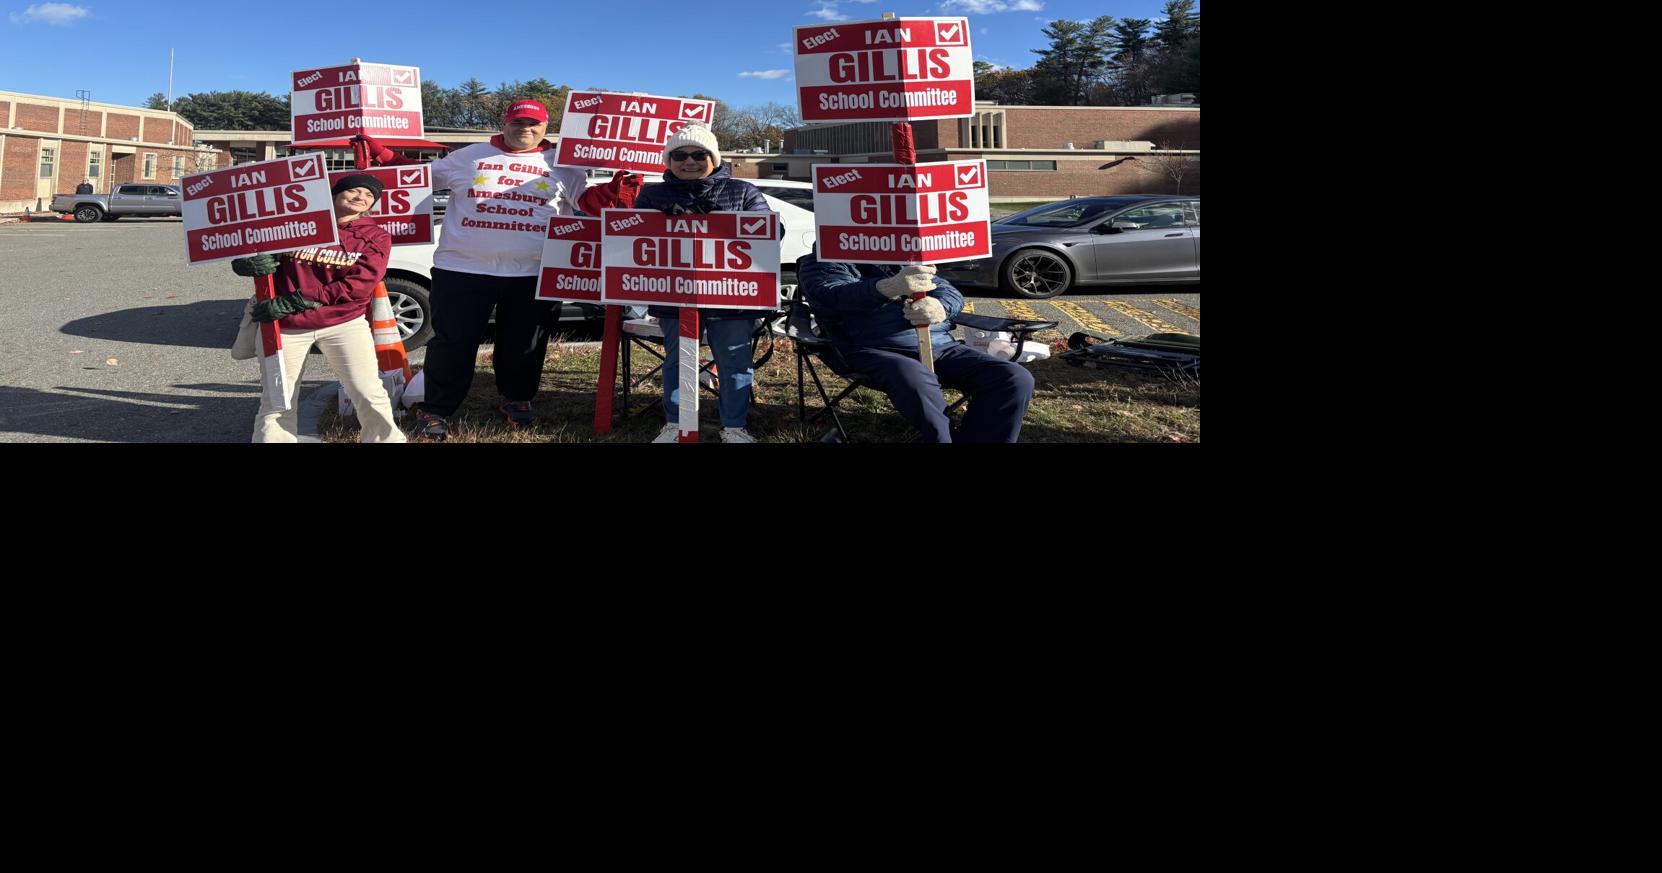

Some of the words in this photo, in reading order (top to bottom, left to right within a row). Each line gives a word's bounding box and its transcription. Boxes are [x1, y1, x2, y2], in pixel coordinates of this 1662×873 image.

[802, 27, 840, 50] Elect
[865, 27, 911, 45] IAN
[828, 48, 951, 83] GILLIS
[297, 71, 323, 87] Elect
[315, 86, 403, 112] GILLIS
[574, 95, 603, 110] Elect
[620, 100, 657, 114] IAN
[819, 90, 874, 110] School
[879, 88, 957, 109] Committee
[307, 116, 344, 133] School
[347, 114, 409, 129] Committee
[573, 143, 616, 161] School
[477, 161, 504, 171] Ian
[508, 162, 550, 177] Gillis
[822, 168, 863, 189] Elect
[888, 173, 932, 188] IAN
[186, 175, 214, 196] Elect
[230, 170, 267, 188] IAN
[497, 175, 524, 187] for
[207, 184, 308, 225] GILLIS
[467, 187, 549, 206] Amesbury
[476, 203, 534, 217] School
[850, 191, 969, 225] GILLIS
[553, 220, 585, 236] Elect
[609, 213, 645, 232] Elect
[665, 219, 709, 234] IAN
[201, 230, 242, 251] School
[246, 220, 317, 244] Committee
[839, 232, 896, 251] School
[901, 230, 975, 252] Committee
[633, 237, 752, 270] GILLIS
[622, 273, 671, 293] School
[675, 276, 758, 297] Committee
